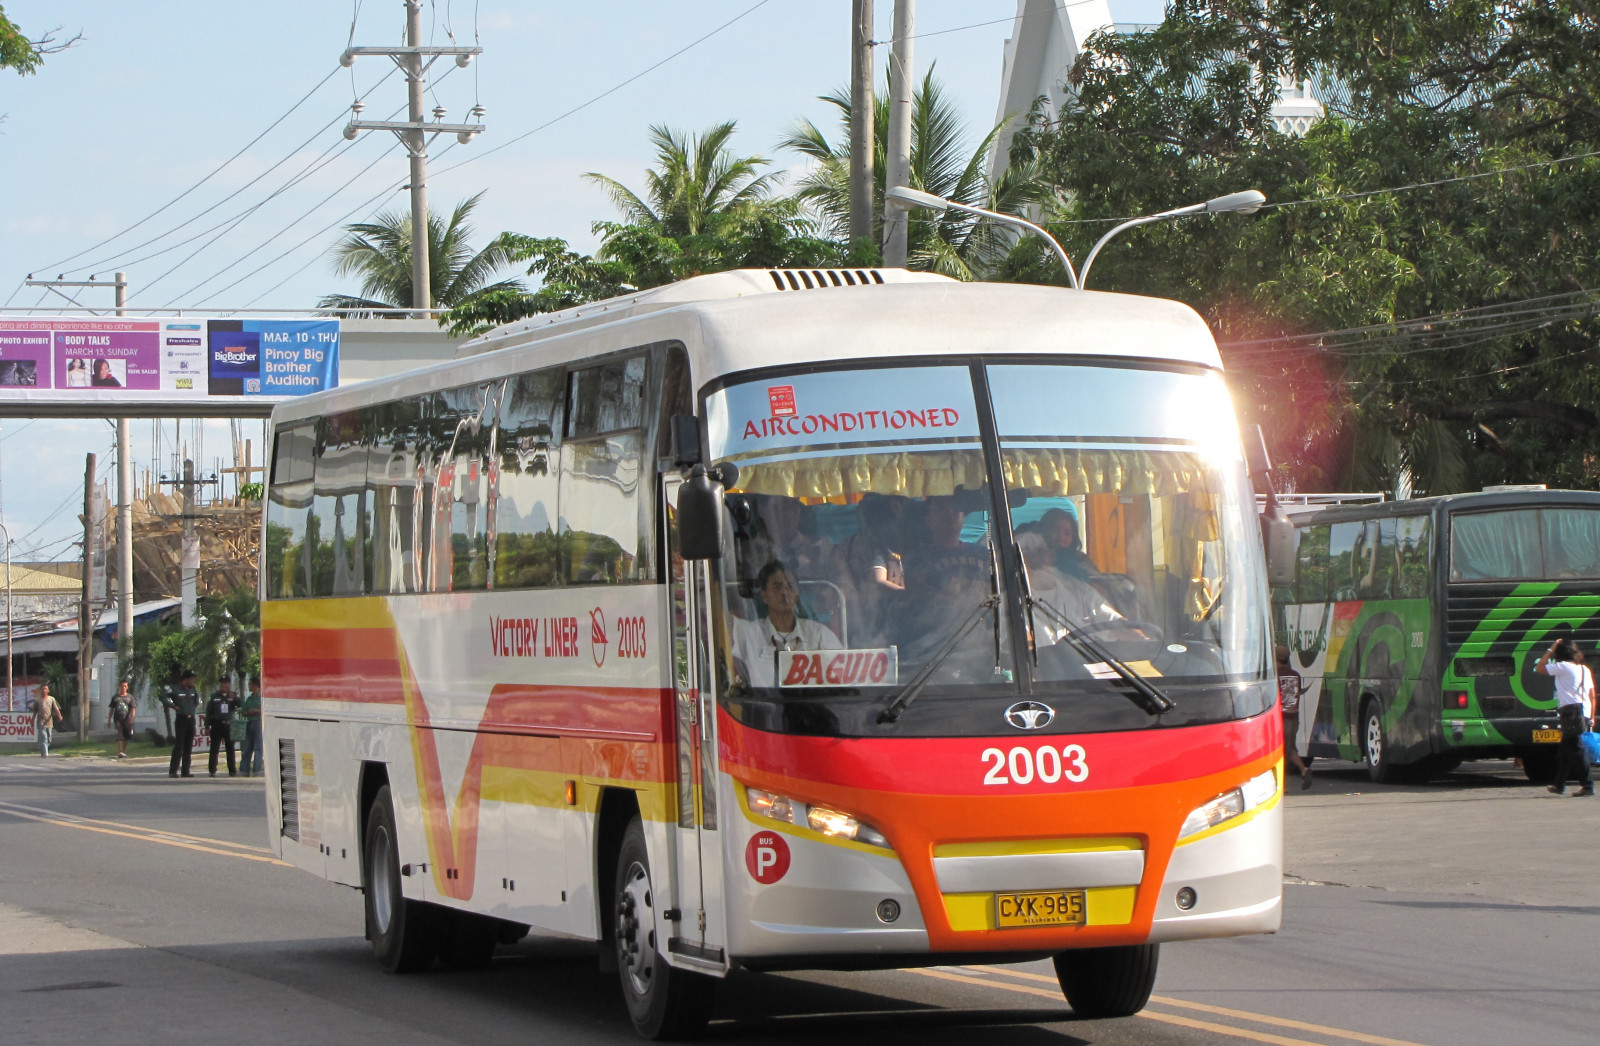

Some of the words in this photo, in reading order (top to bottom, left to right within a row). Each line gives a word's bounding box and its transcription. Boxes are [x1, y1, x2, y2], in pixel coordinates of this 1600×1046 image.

[31, 322, 51, 330] dining
[53, 323, 90, 331] experience
[91, 322, 102, 330] like
[0, 337, 21, 345] PHOTO
[23, 337, 49, 345] EXHIBIT
[65, 335, 86, 345] BODY
[88, 336, 110, 346] TALKS
[264, 332, 292, 343] MAR.
[296, 332, 308, 343] 10
[318, 332, 338, 343] THU
[65, 347, 94, 356] MARCH
[108, 348, 138, 357] SUNDAY
[265, 348, 300, 362] Pinoy
[304, 348, 324, 362] Big
[265, 361, 312, 373] Brother
[265, 374, 319, 386] Audition
[743, 408, 959, 440] AIRCONDITIONED
[489, 613, 538, 657] VICTORY
[544, 617, 578, 657] LINER
[617, 616, 646, 658] 2003
[783, 652, 888, 685] BAGUIO
[0, 714, 34, 725] SLOW
[0, 725, 35, 736] DOWN
[981, 744, 1089, 785] 2003
[759, 837, 774, 845] BUS
[757, 847, 777, 877] P
